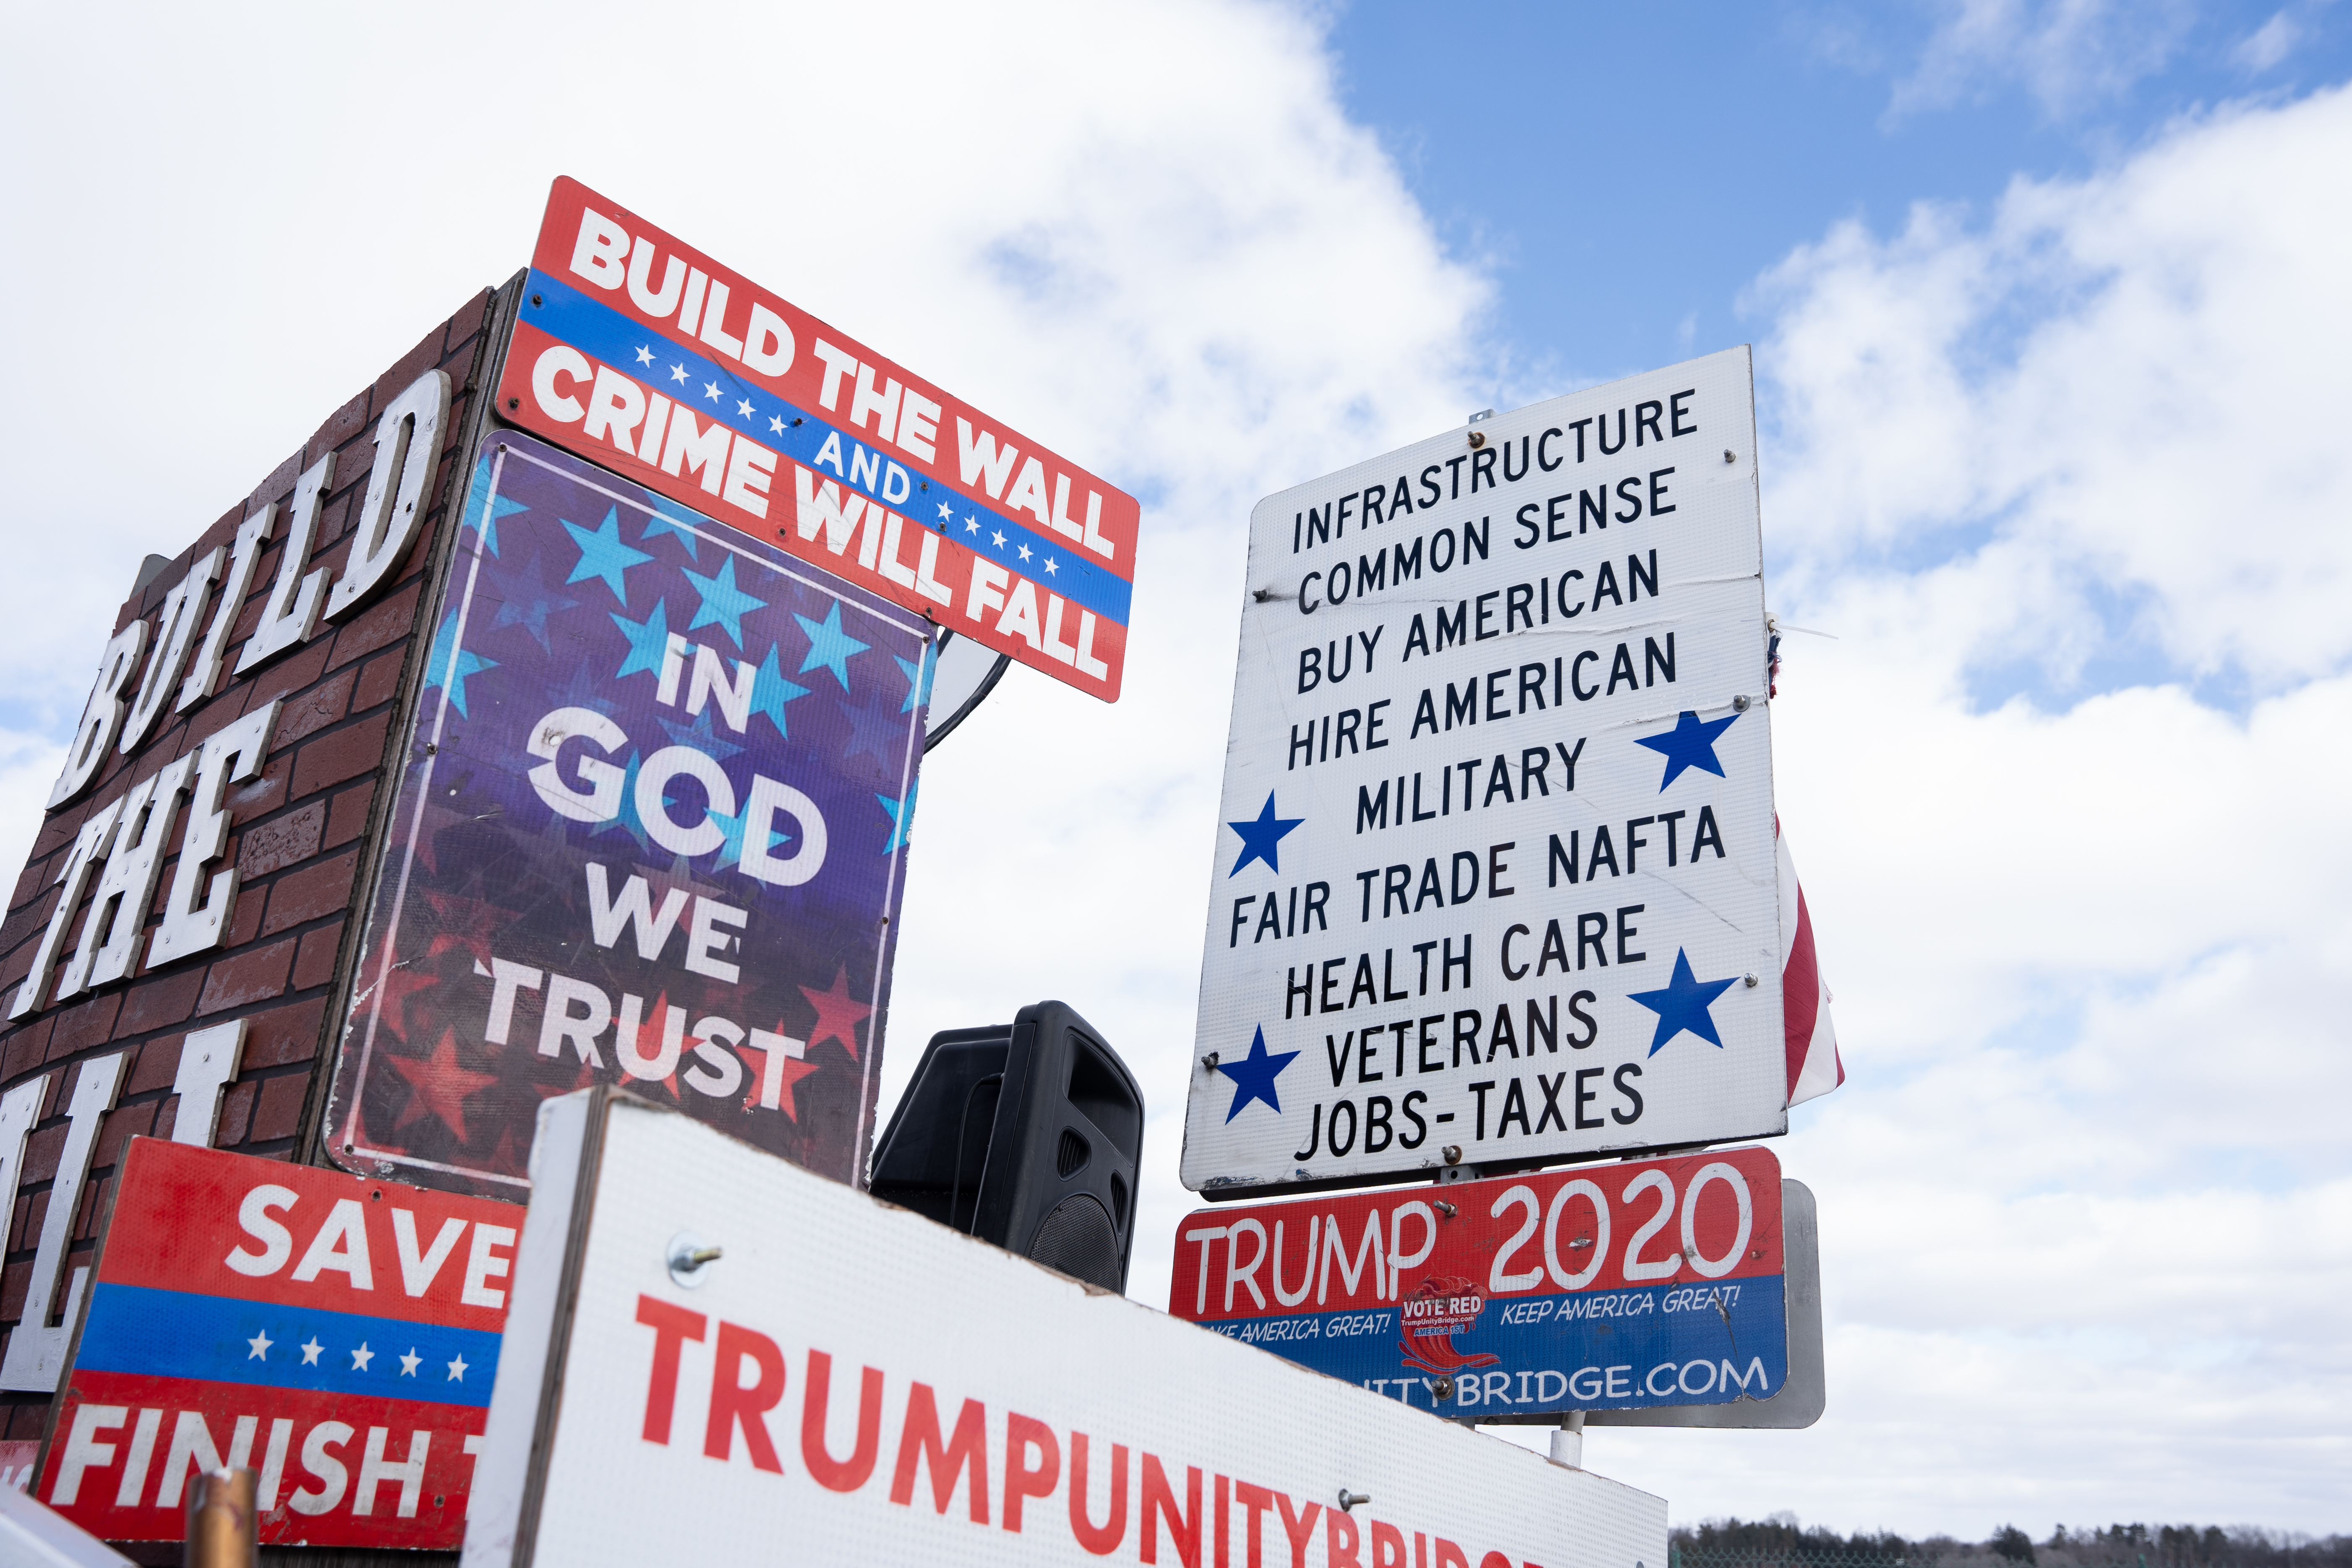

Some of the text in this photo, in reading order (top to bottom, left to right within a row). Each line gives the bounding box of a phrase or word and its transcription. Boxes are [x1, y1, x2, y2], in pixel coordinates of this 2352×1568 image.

[569, 207, 1115, 559] BUILD THE WALL
[533, 346, 1108, 681] CRIME WILL FALL
[814, 431, 911, 504] AND
[1293, 389, 1697, 553] INFRASTRUCTURE
[45, 369, 452, 812] BUILD
[1299, 467, 1676, 615] COMMON SENSE
[656, 631, 757, 734] IN
[1297, 549, 1659, 694] BUY AMERICAN
[1288, 632, 1677, 770] HIRE AMERICAN
[527, 707, 828, 887] GOD
[1356, 737, 1587, 835] MILITARY
[8, 700, 284, 1023] THE
[586, 861, 748, 984] WE
[1230, 805, 1725, 948] FAIR TRADE NAFTA
[1285, 904, 1647, 1020] HEALTH CARE
[474, 957, 806, 1111] TRUST
[1326, 990, 1598, 1087] VETERANS
[224, 1184, 517, 1309] SAVE
[1185, 1161, 1753, 1314] TRUMP 2020
[1238, 1318, 1320, 1343] AMERICA
[1326, 1314, 1391, 1337] GREAT!
[1401, 1316, 1474, 1326] TrumpUnityBridge.com
[1403, 1296, 1481, 1318] VOTE RED
[1414, 1325, 1465, 1336] AMERICA 1ST
[1501, 1285, 1741, 1325] KEEP AMERICA GREAT!
[49, 1403, 431, 1518] FINISH
